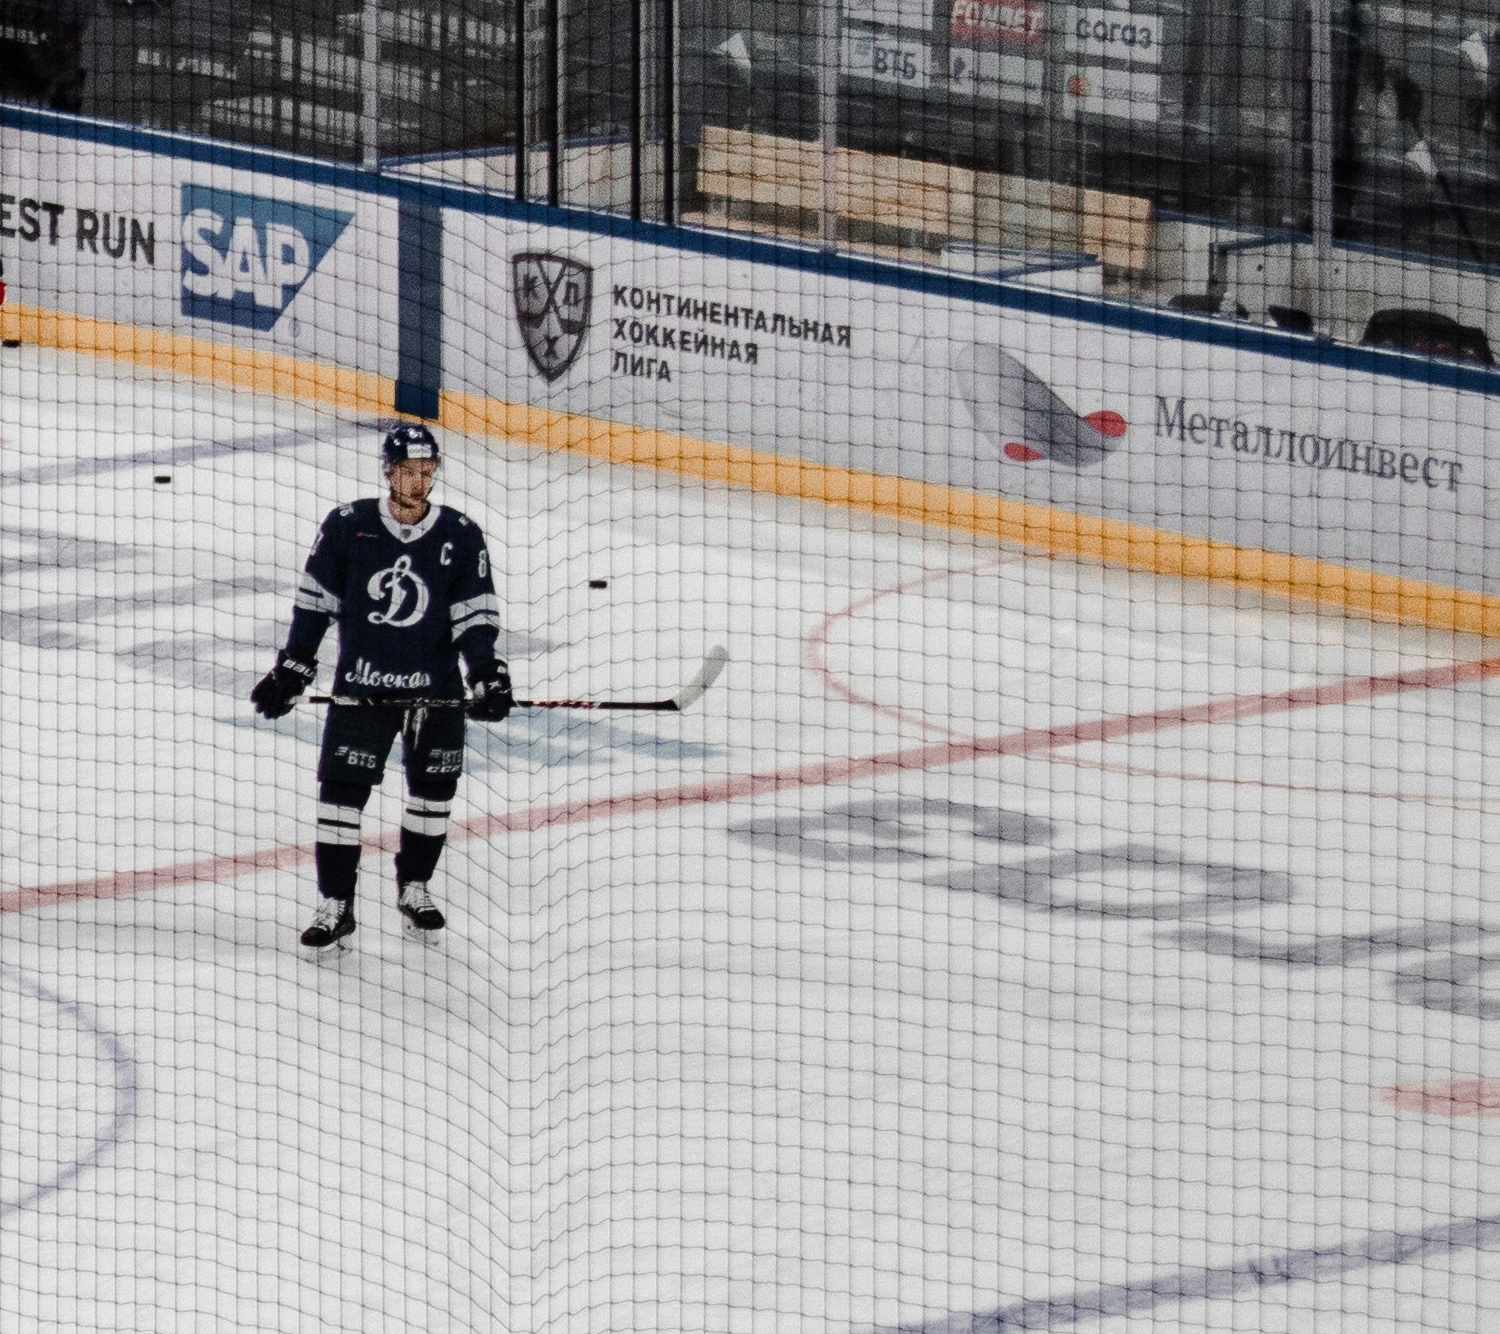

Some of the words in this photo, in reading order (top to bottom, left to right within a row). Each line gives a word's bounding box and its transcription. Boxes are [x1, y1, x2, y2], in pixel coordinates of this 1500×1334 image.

[872, 45, 917, 81] ВТБ
[75, 208, 155, 266] RUN
[182, 208, 310, 309] SAP
[612, 317, 758, 365] ХОККЕЙНАЯ
[613, 285, 852, 349] КОНТИНЕНТАЛЬНАЯ
[612, 351, 672, 383] ЛИГА
[1155, 394, 1463, 493] Металлоинвест
